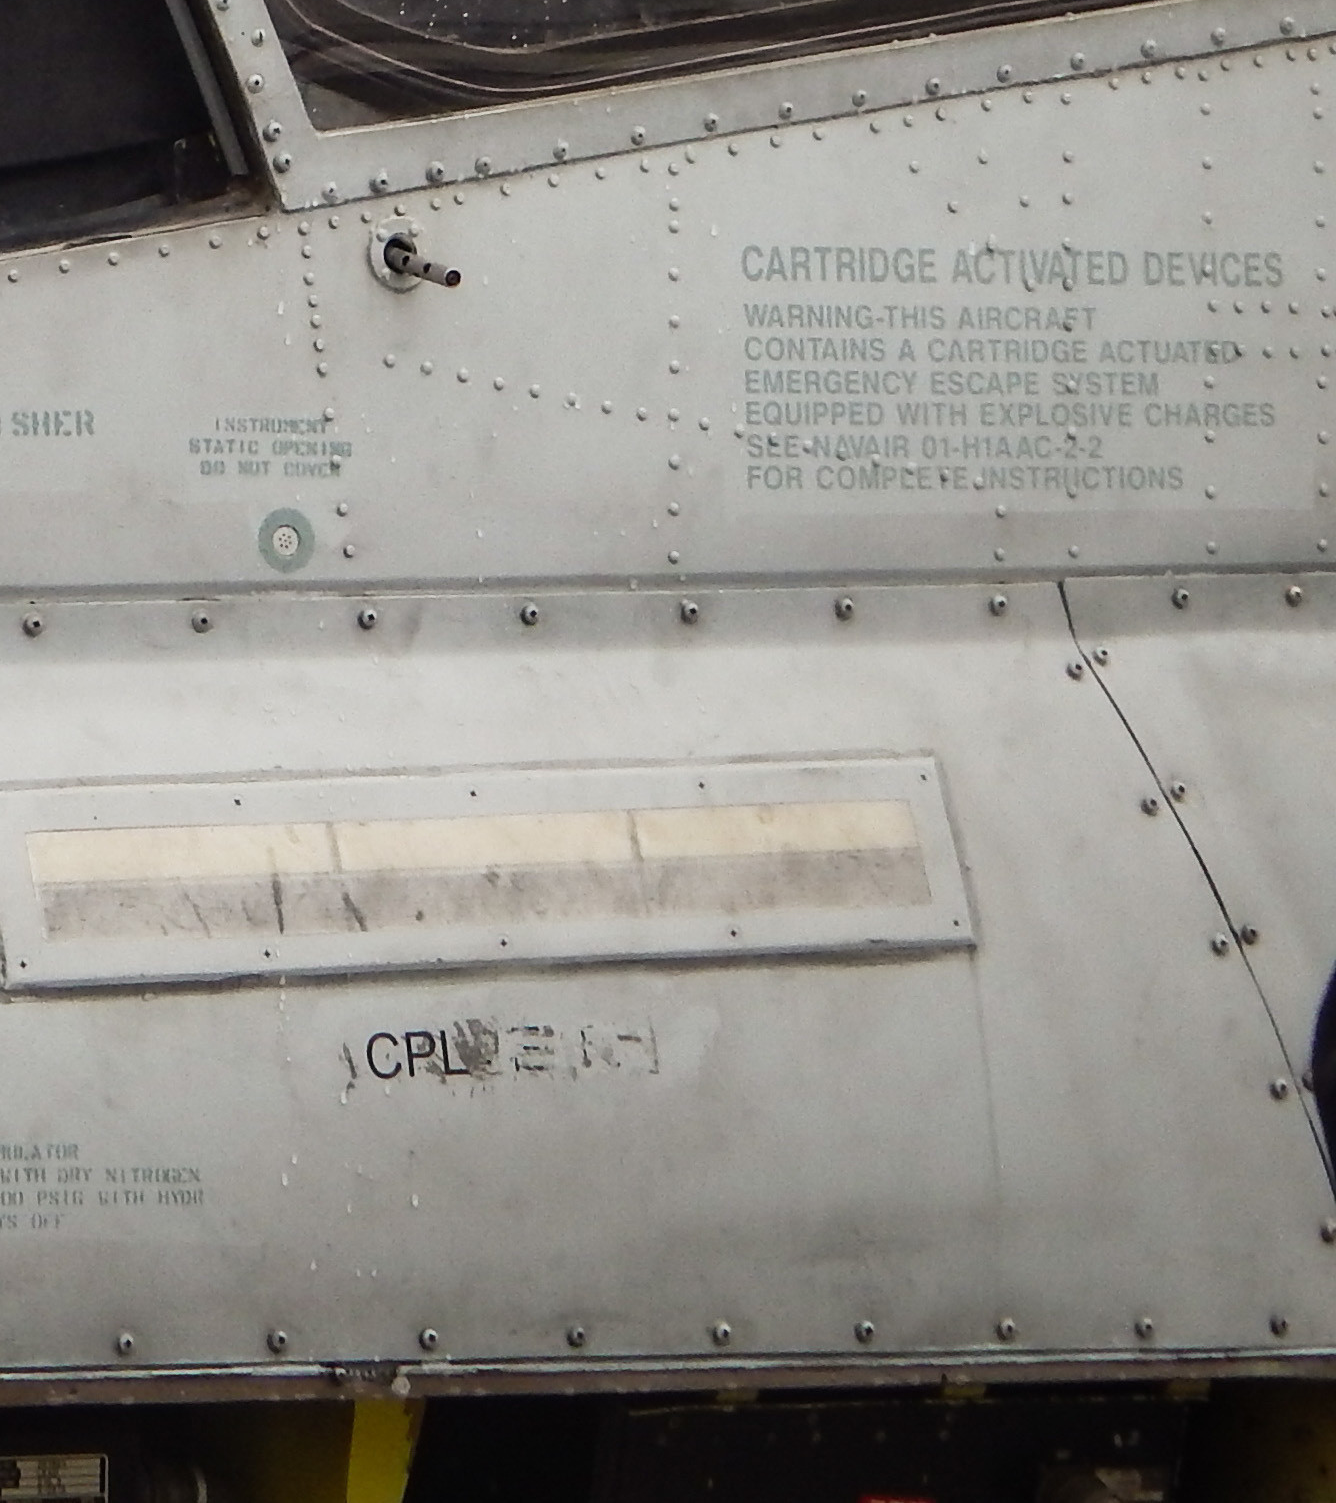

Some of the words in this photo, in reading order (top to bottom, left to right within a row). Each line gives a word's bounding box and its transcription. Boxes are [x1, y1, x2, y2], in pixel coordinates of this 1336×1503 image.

[741, 245, 936, 284] CARTRIDGE
[952, 248, 1128, 288] ACTIVATED
[1145, 251, 1285, 288] DEVICES
[958, 305, 1096, 331] AIRCRAFT
[744, 338, 887, 363] CONTAINS
[898, 339, 916, 363] A
[928, 339, 1088, 364] CARTRIDGE
[1099, 340, 1239, 364] ACTUATED
[744, 370, 917, 396] EMERGENCY
[931, 371, 1040, 396] ESCAPE
[1052, 372, 1160, 397] SYSTEM
[745, 403, 885, 427] EQUIPPED
[896, 404, 967, 427] WITH
[981, 403, 1133, 428] EXPLOSIVE
[1144, 403, 1276, 428] CHARGES
[188, 438, 259, 456] STATIC
[747, 435, 799, 459] SEE
[811, 436, 910, 460] NAVAIR
[746, 466, 804, 491] FOR
[816, 466, 968, 491] COMPLETE
[980, 466, 1184, 492] INSTRUCTIONS
